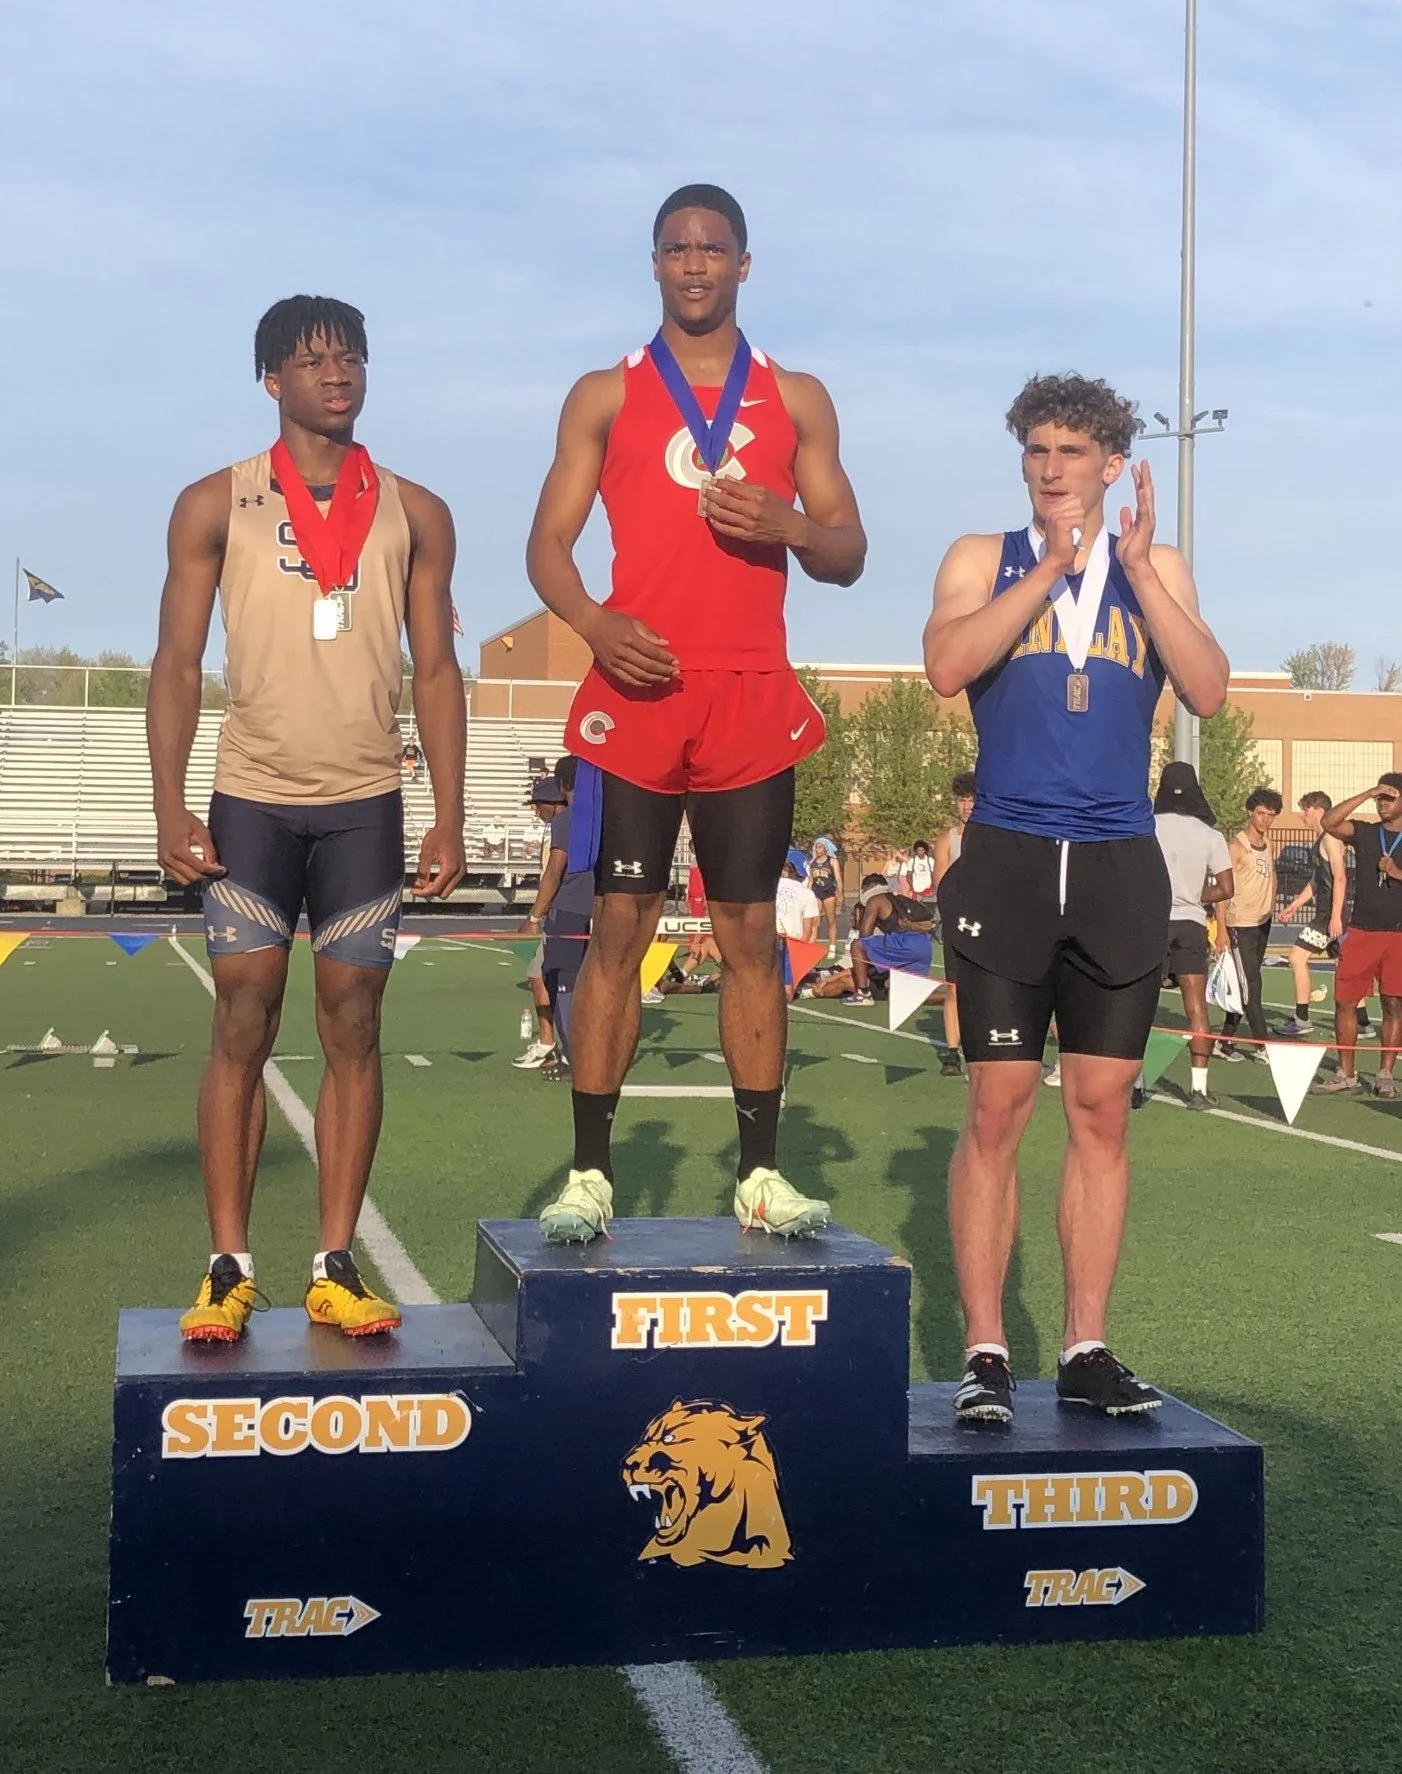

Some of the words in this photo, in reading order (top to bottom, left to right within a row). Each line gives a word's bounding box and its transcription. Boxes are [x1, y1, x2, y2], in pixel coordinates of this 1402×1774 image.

[611, 1290, 828, 1349] FIRST
[162, 1394, 472, 1458] SECOND
[972, 1470, 1198, 1530] THIRD
[1024, 1568, 1121, 1607] TRAC
[243, 1597, 353, 1638] TRAC
